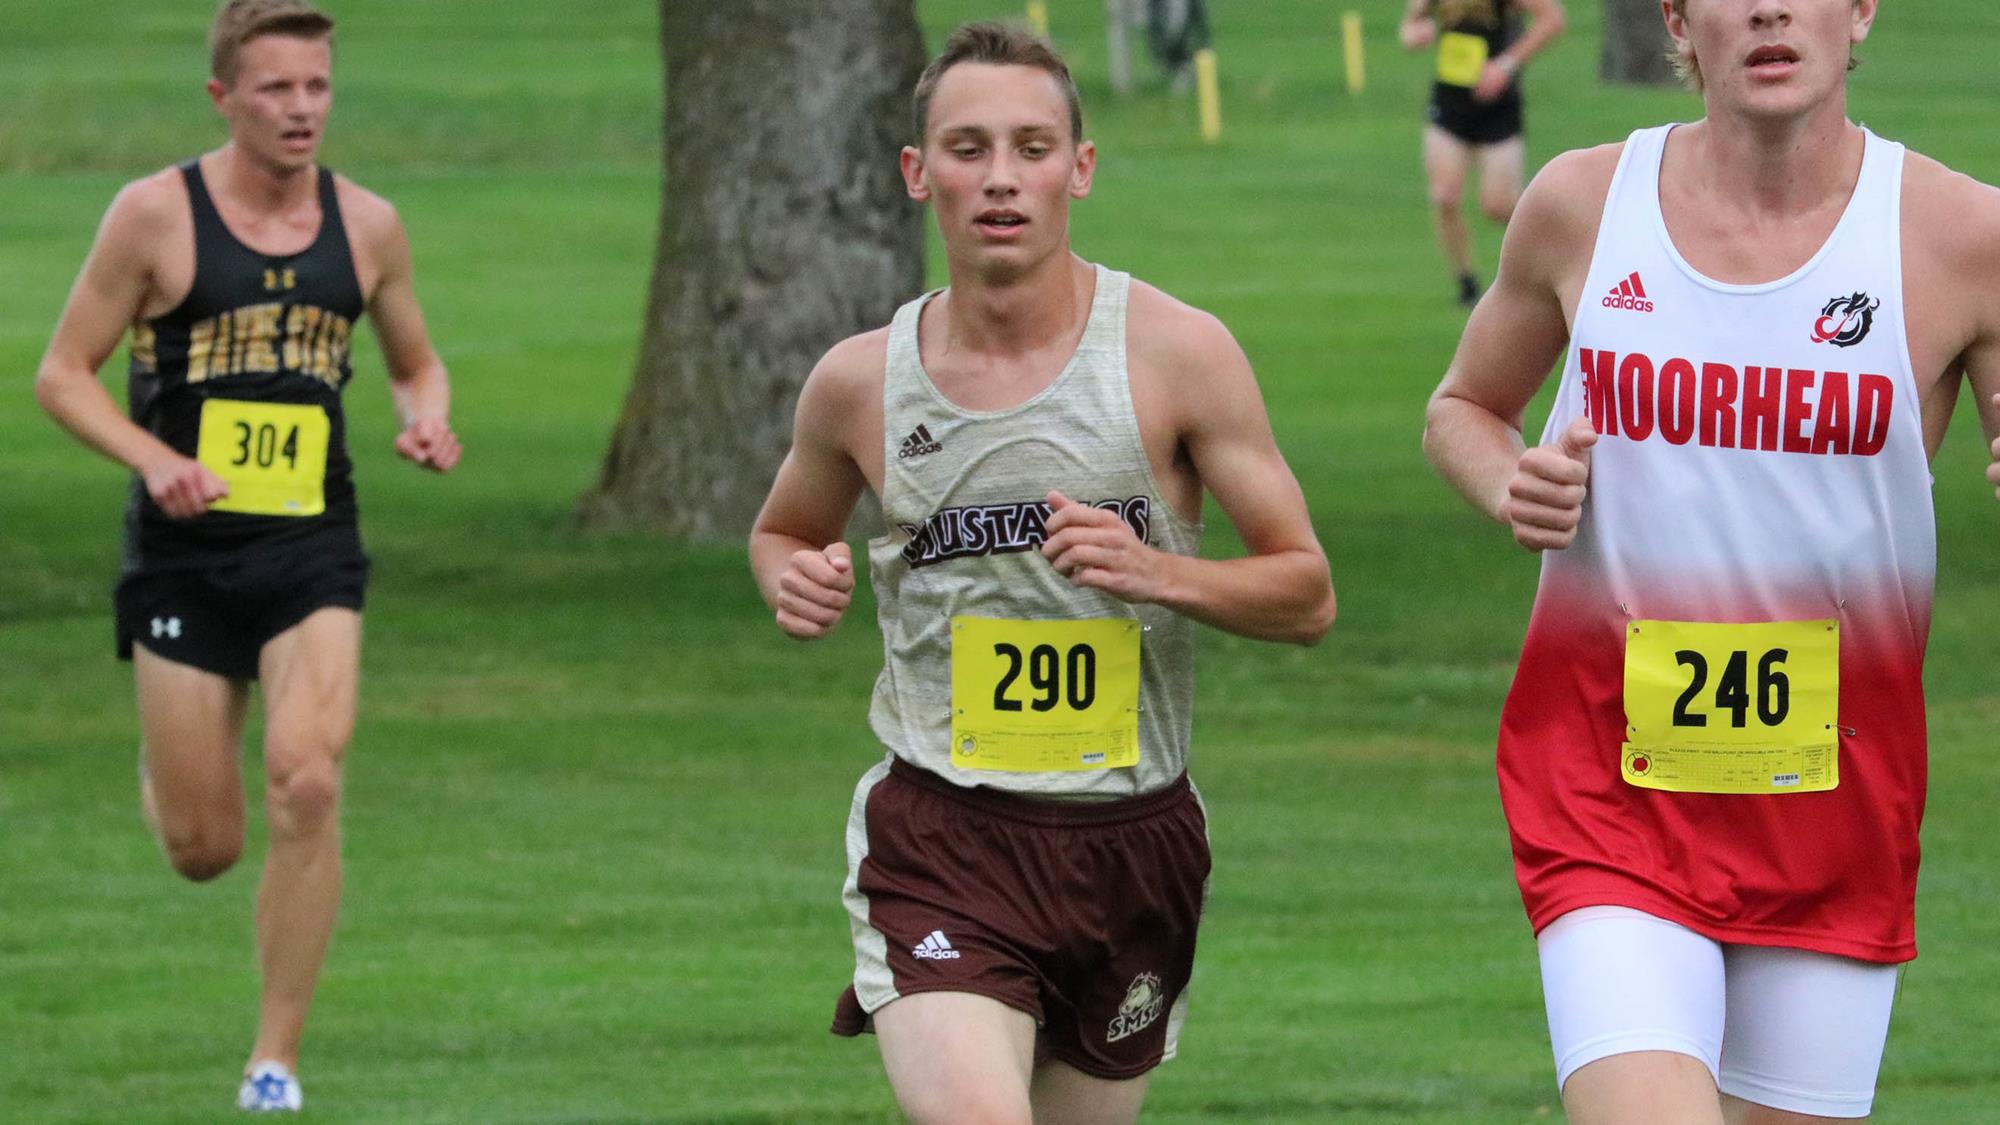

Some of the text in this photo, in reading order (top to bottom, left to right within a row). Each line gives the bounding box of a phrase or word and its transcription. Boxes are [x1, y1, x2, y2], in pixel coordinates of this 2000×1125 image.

[1601, 294, 1654, 313] adidas
[1579, 347, 1894, 457] MOORHEAD
[232, 421, 300, 470] 304
[898, 440, 944, 459] adidas
[993, 642, 1096, 712] 290
[1672, 647, 1790, 728] 246
[911, 948, 961, 960] adidas
